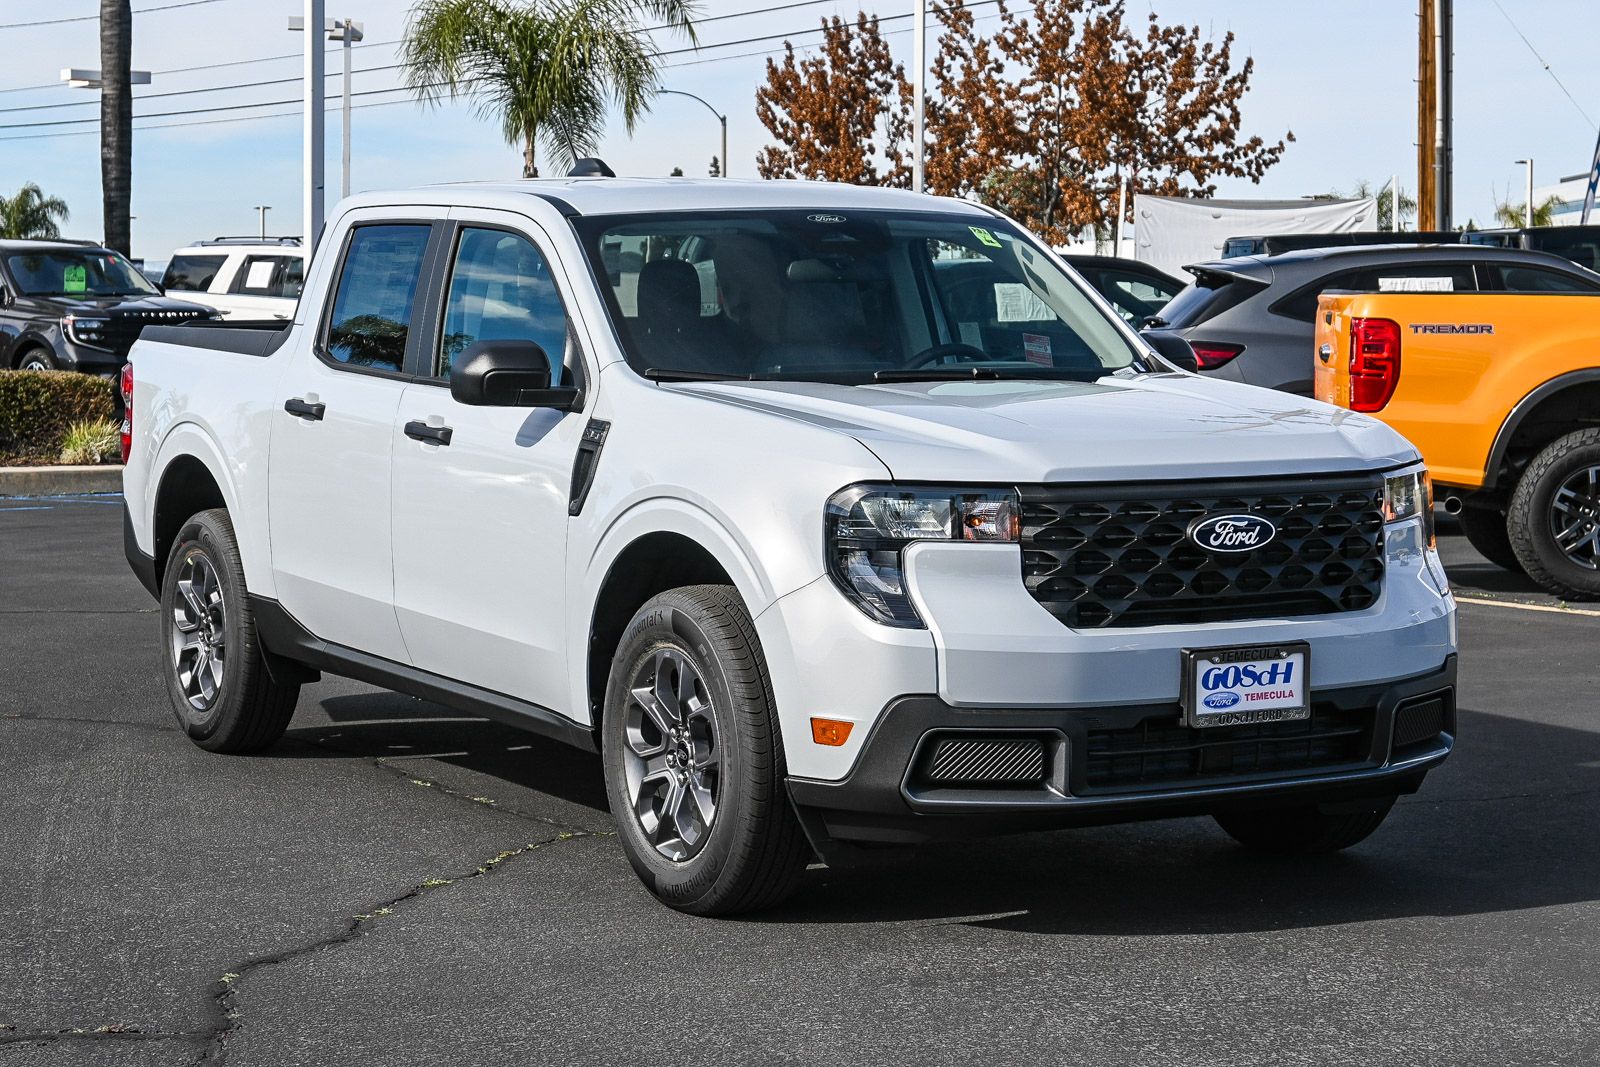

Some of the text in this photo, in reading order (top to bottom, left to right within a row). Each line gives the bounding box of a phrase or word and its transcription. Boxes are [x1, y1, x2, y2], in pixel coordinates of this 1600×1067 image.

[1409, 324, 1494, 334] TREMOR
[1209, 520, 1261, 546] Ford
[1220, 648, 1280, 662] TEMECULA
[1245, 689, 1294, 702] TEMECULA
[1257, 708, 1282, 722] FORD
